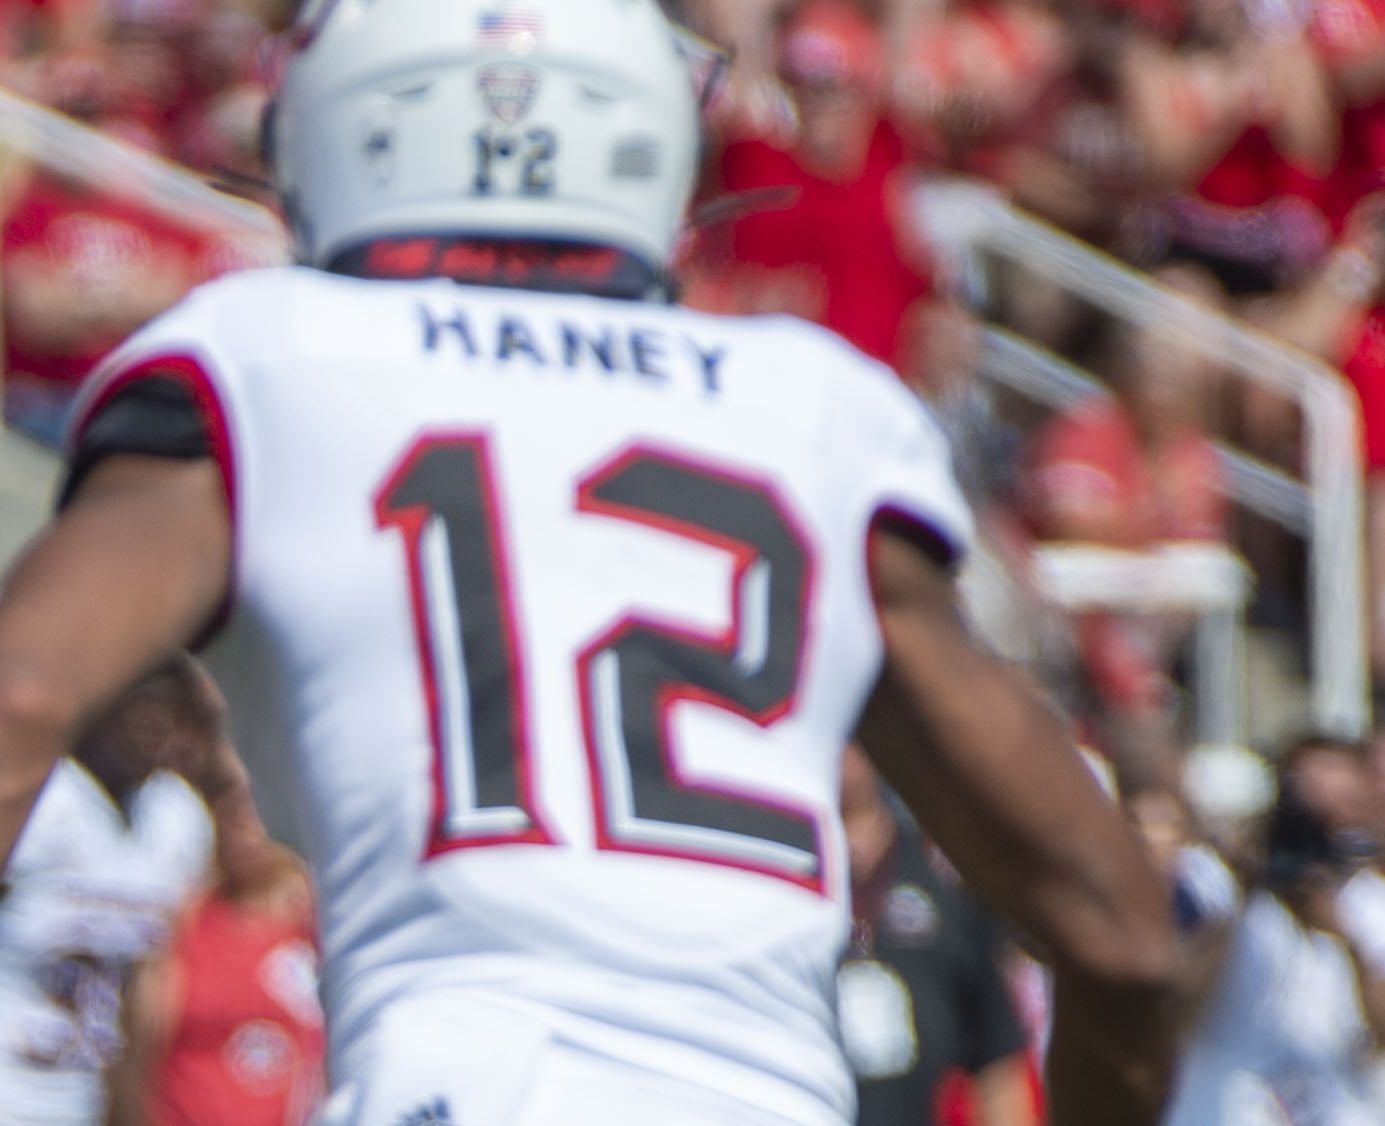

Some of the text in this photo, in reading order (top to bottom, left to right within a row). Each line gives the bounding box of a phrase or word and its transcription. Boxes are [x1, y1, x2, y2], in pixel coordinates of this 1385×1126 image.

[472, 126, 558, 198] 12
[415, 298, 726, 394] HANEY
[372, 425, 832, 898] 12
